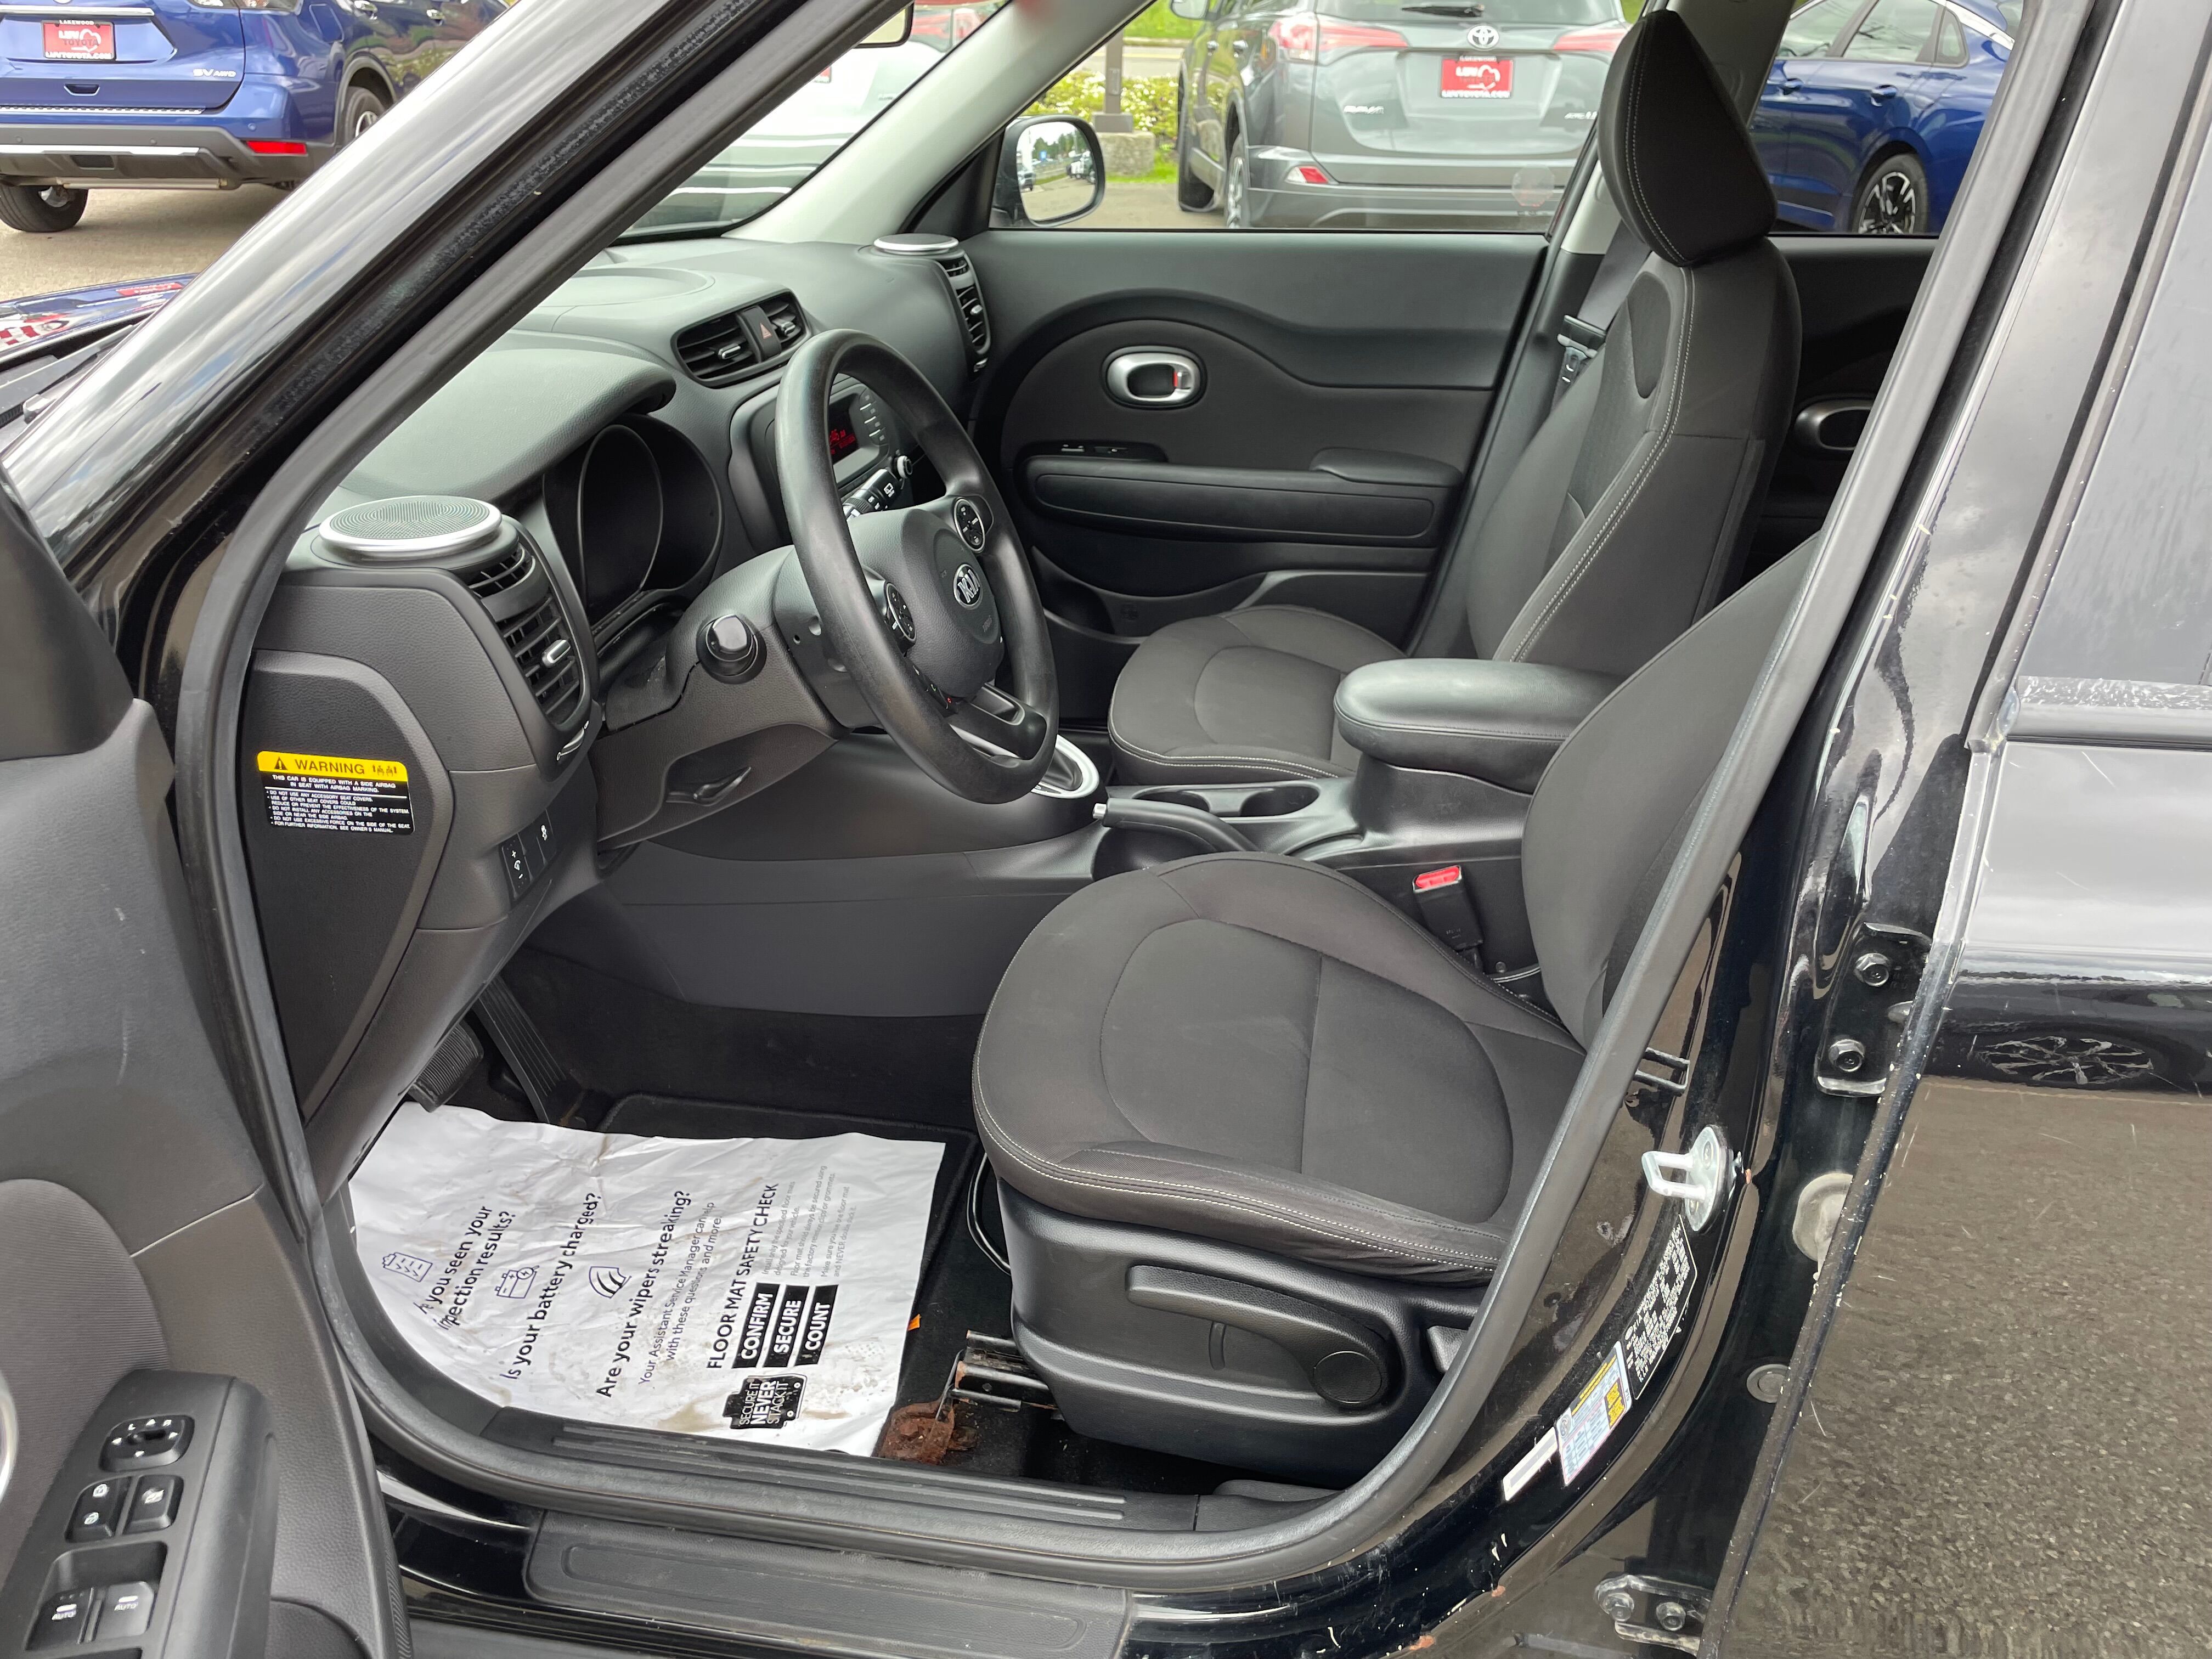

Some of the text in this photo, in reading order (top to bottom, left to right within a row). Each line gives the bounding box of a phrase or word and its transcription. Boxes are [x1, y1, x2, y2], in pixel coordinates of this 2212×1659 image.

[957, 569, 980, 603] KIA
[295, 759, 365, 774] WARNING
[426, 1206, 492, 1304] you seen your
[476, 1211, 516, 1264] results?
[807, 1242, 817, 1266] factory
[821, 1261, 831, 1277] Make
[837, 1199, 847, 1213] floor
[836, 1242, 845, 1263] NEVER
[499, 1193, 601, 1379] Is your battery charged?
[596, 1191, 691, 1398] Are your wipers streaking?
[638, 1359, 656, 1385] Your
[649, 1305, 673, 1357] Assistant
[665, 1278, 686, 1307] Service
[696, 1217, 707, 1233] can
[706, 1183, 779, 1368] FLOOR MAT SAFETY CHECK
[667, 1335, 681, 1361] with
[674, 1306, 690, 1334] these
[702, 1244, 714, 1264] and
[741, 1293, 774, 1359] CONFIRM
[773, 1299, 802, 1353] SECURE
[805, 1302, 830, 1351] COUNT
[740, 1391, 758, 1425] SECURE
[751, 1380, 777, 1425] NEVER
[767, 1381, 788, 1424] STACK IT
[114, 1602, 138, 1611] AUTO
